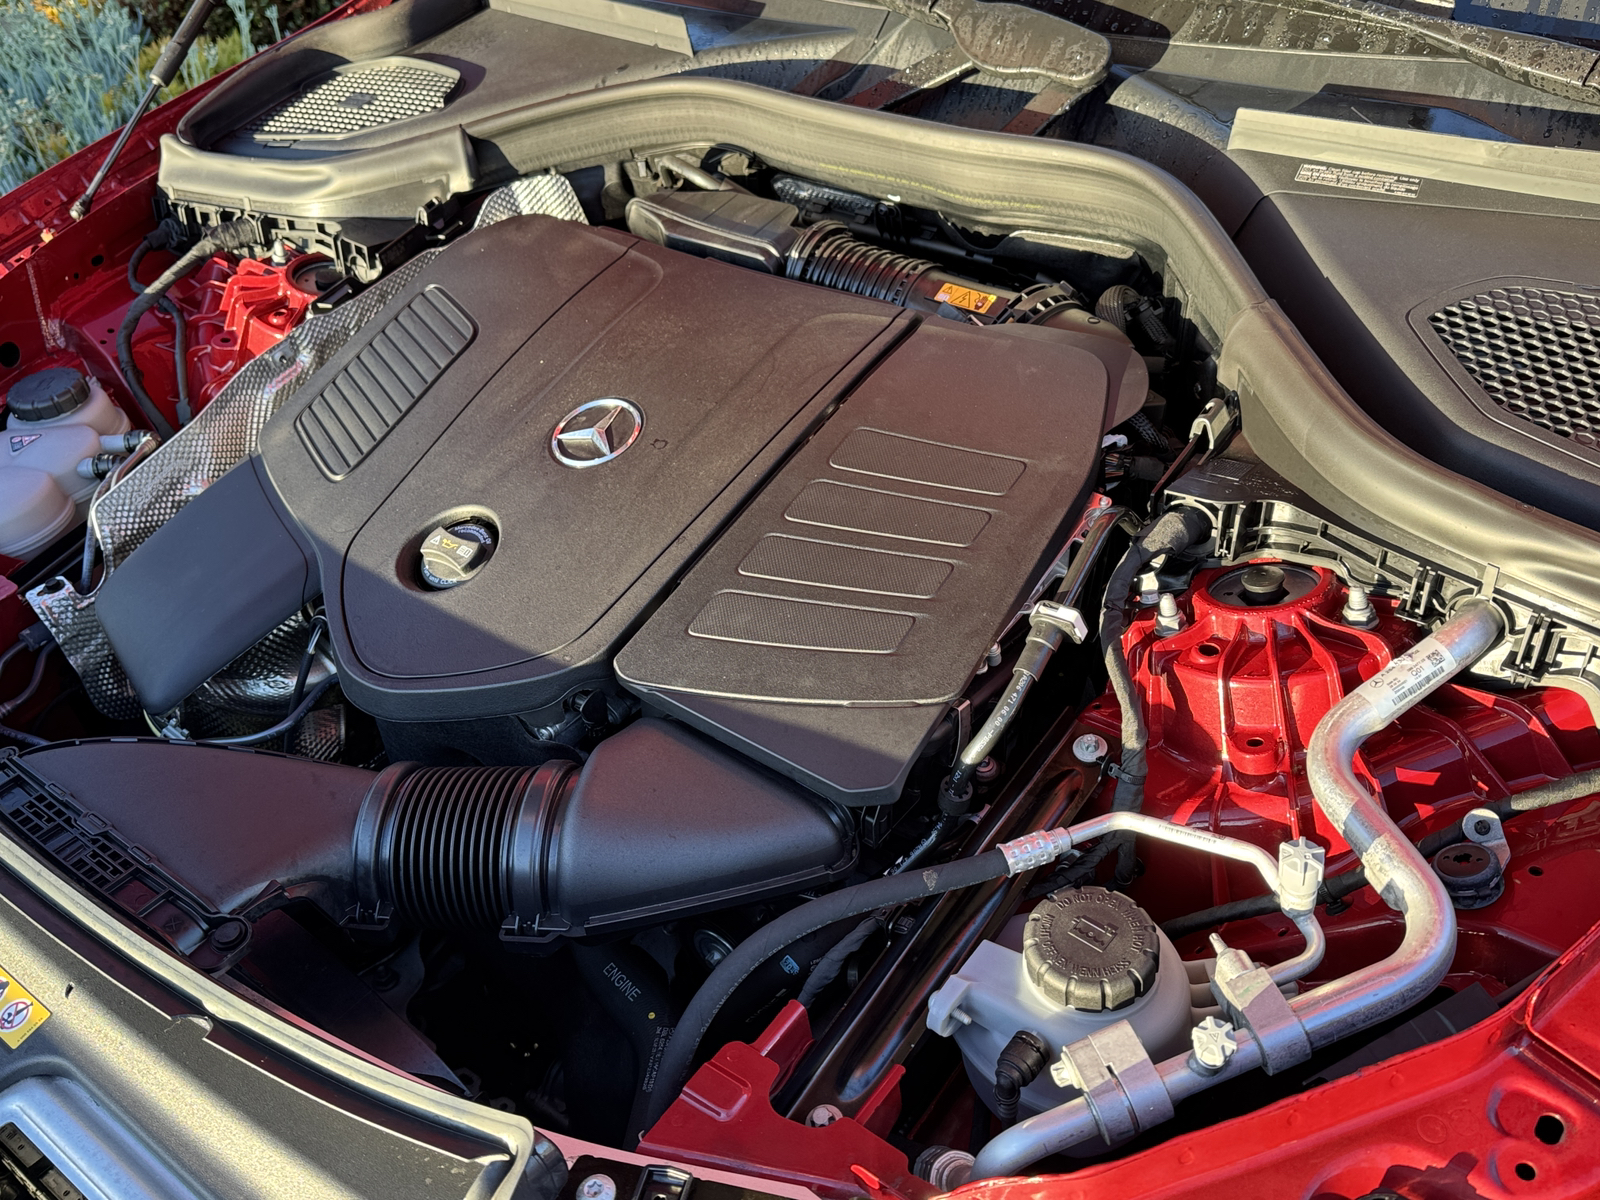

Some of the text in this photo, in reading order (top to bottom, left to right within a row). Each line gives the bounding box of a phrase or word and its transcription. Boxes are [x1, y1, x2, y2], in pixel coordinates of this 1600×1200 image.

[1410, 665, 1425, 677] Q01
[1007, 692, 1018, 704] 471
[1055, 897, 1072, 910] DO
[1072, 893, 1094, 904] NOT
[1095, 894, 1124, 911] OPEN
[1130, 933, 1145, 953] HOT
[1040, 913, 1055, 939] NICHT
[1101, 958, 1131, 978] HEISS
[603, 962, 642, 1002] ENGINE
